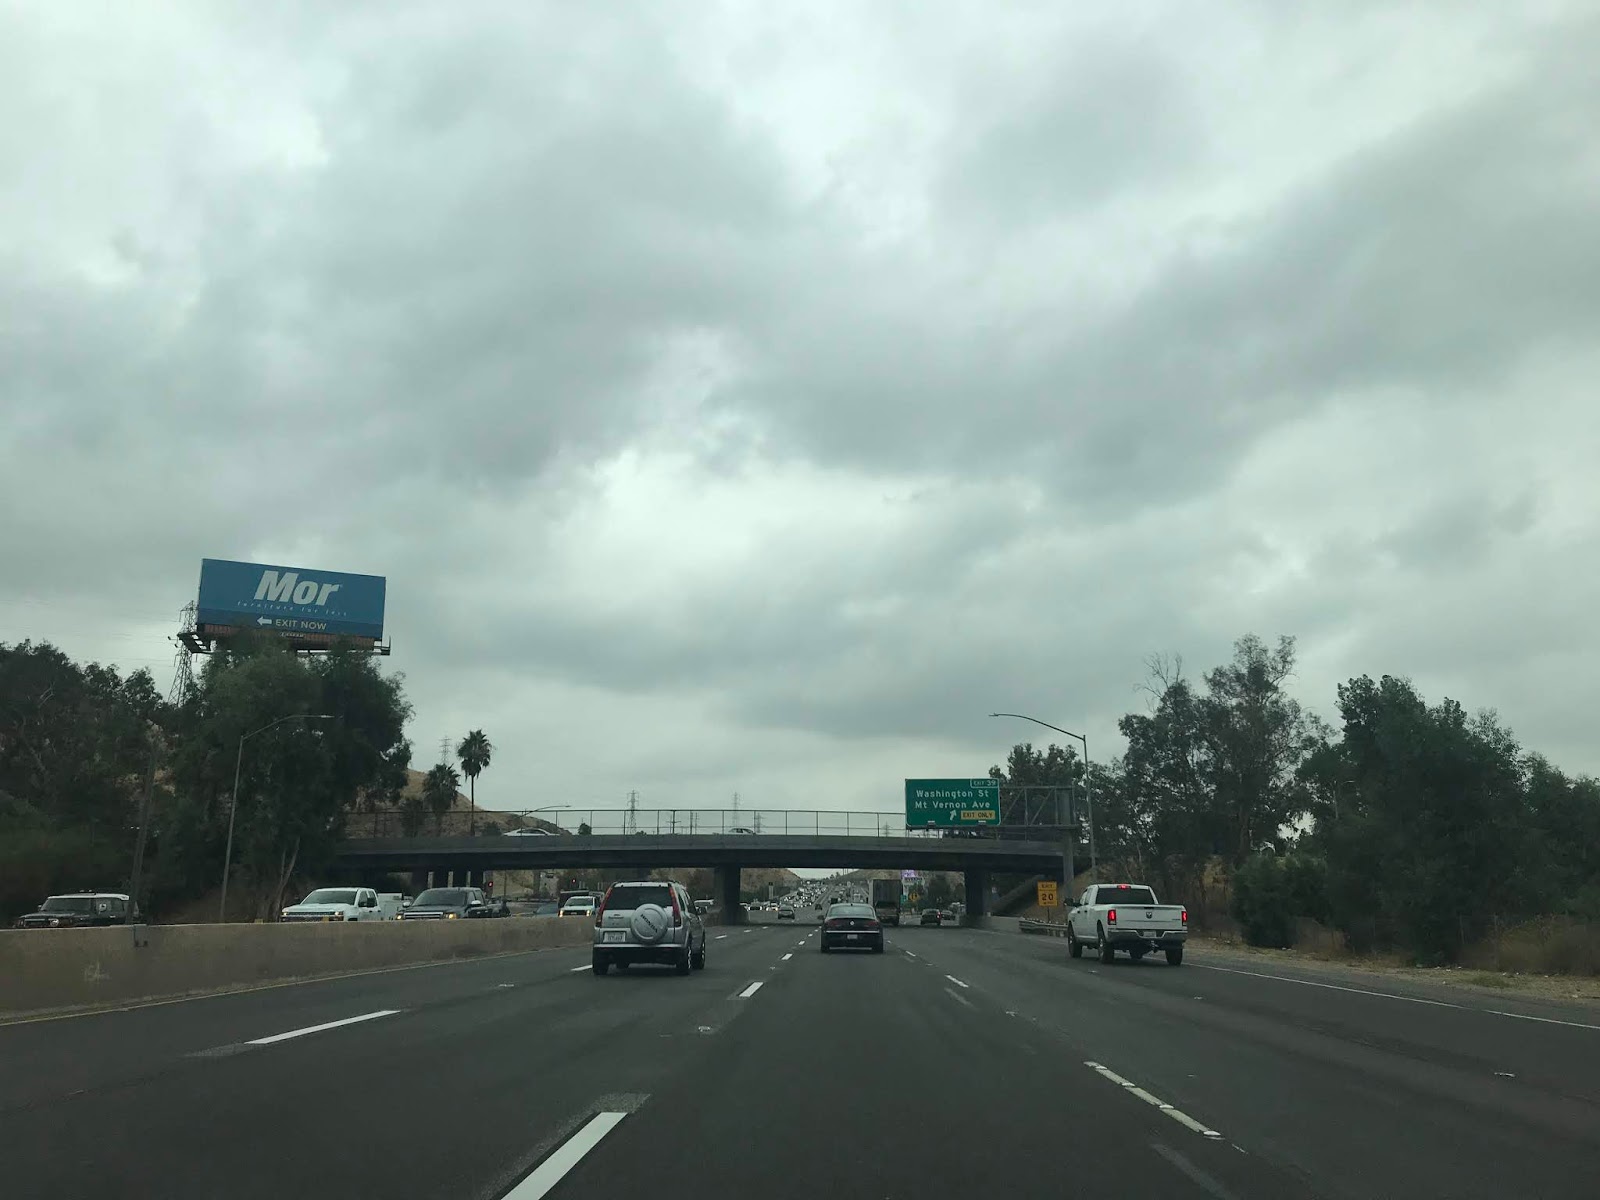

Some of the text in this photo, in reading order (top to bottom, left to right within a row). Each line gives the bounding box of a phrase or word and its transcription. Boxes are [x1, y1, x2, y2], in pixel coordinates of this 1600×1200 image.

[253, 570, 341, 607] Mor
[275, 618, 327, 630] EXIT NOW
[987, 779, 996, 787] 39
[916, 789, 989, 799] Washington St
[915, 801, 991, 809] Mt Vernon Ave
[1041, 893, 1054, 901] 20
